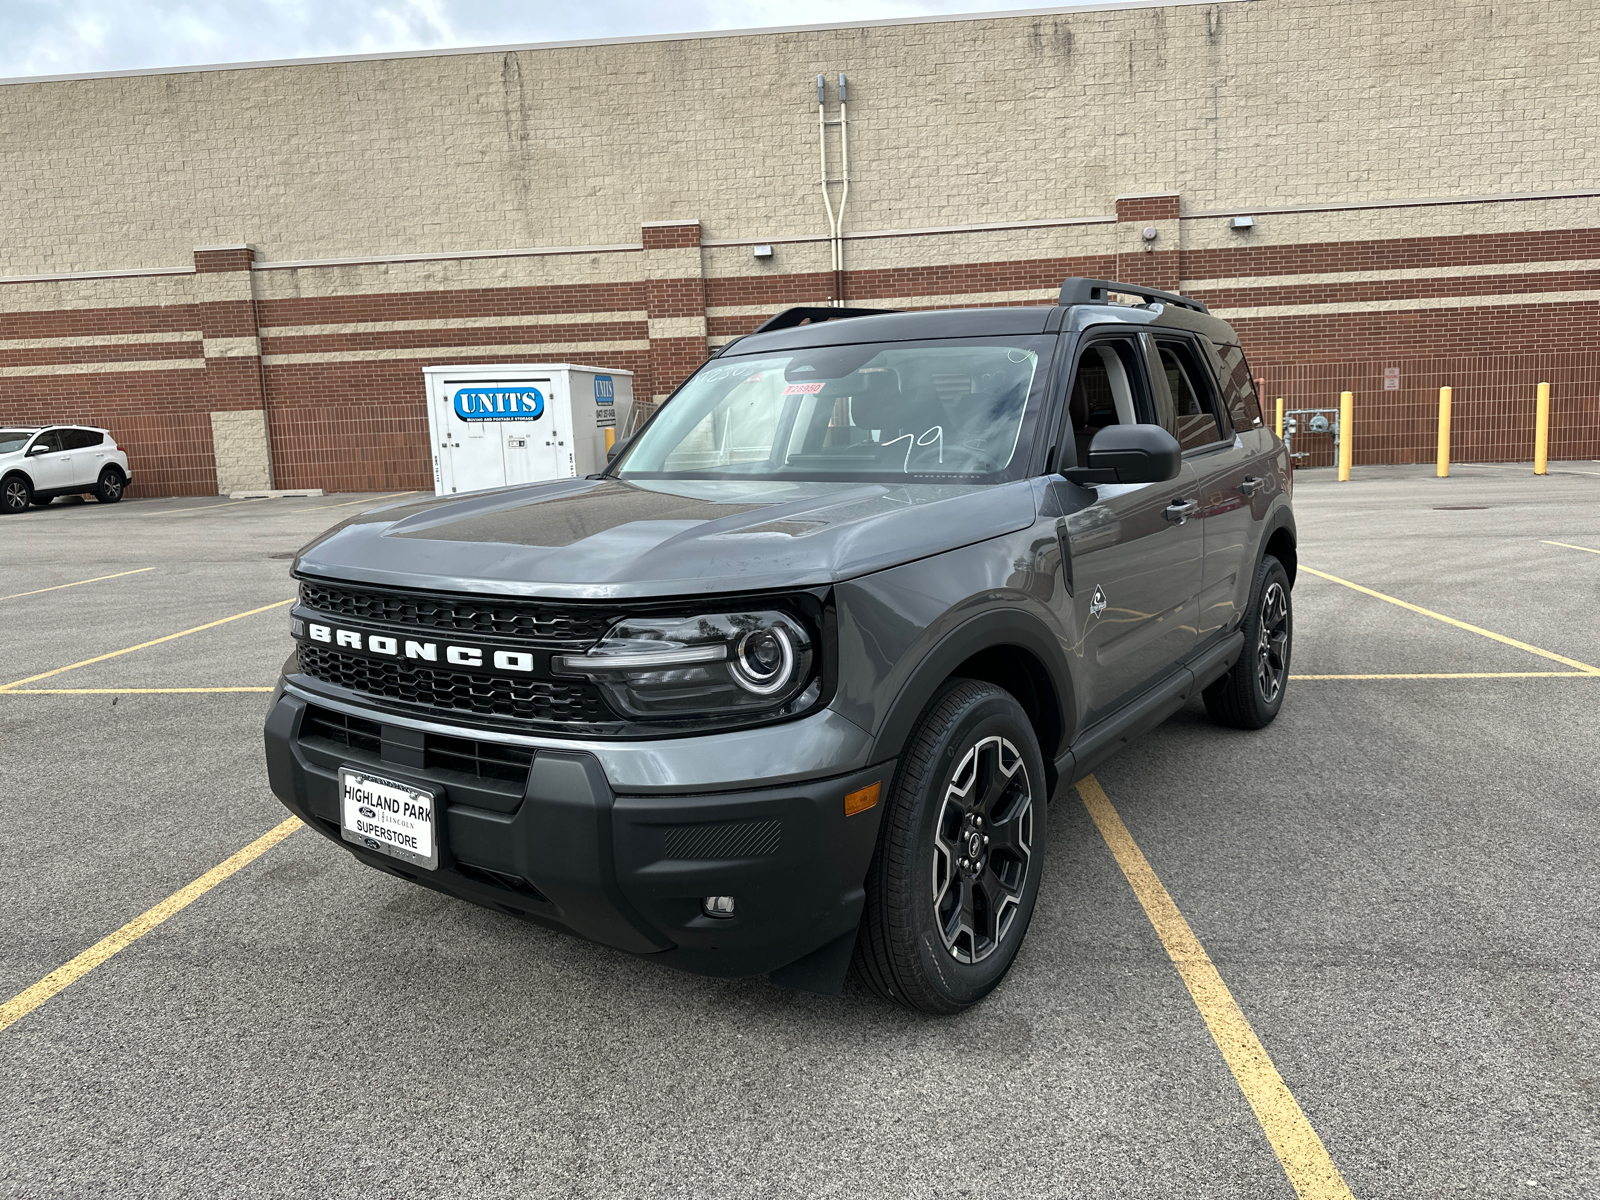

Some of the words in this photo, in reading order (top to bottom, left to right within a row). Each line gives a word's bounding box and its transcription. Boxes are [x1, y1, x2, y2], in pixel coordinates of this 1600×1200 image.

[595, 380, 613, 398] UNITS
[786, 384, 821, 393] T28950
[460, 392, 537, 413] UNITS
[309, 623, 534, 672] BRONCO
[344, 785, 400, 813] HIGHLAND
[403, 802, 431, 823] PARK
[359, 806, 376, 818] Ford
[385, 816, 415, 829] LINCOLN
[356, 820, 418, 849] SUPERSTORE
